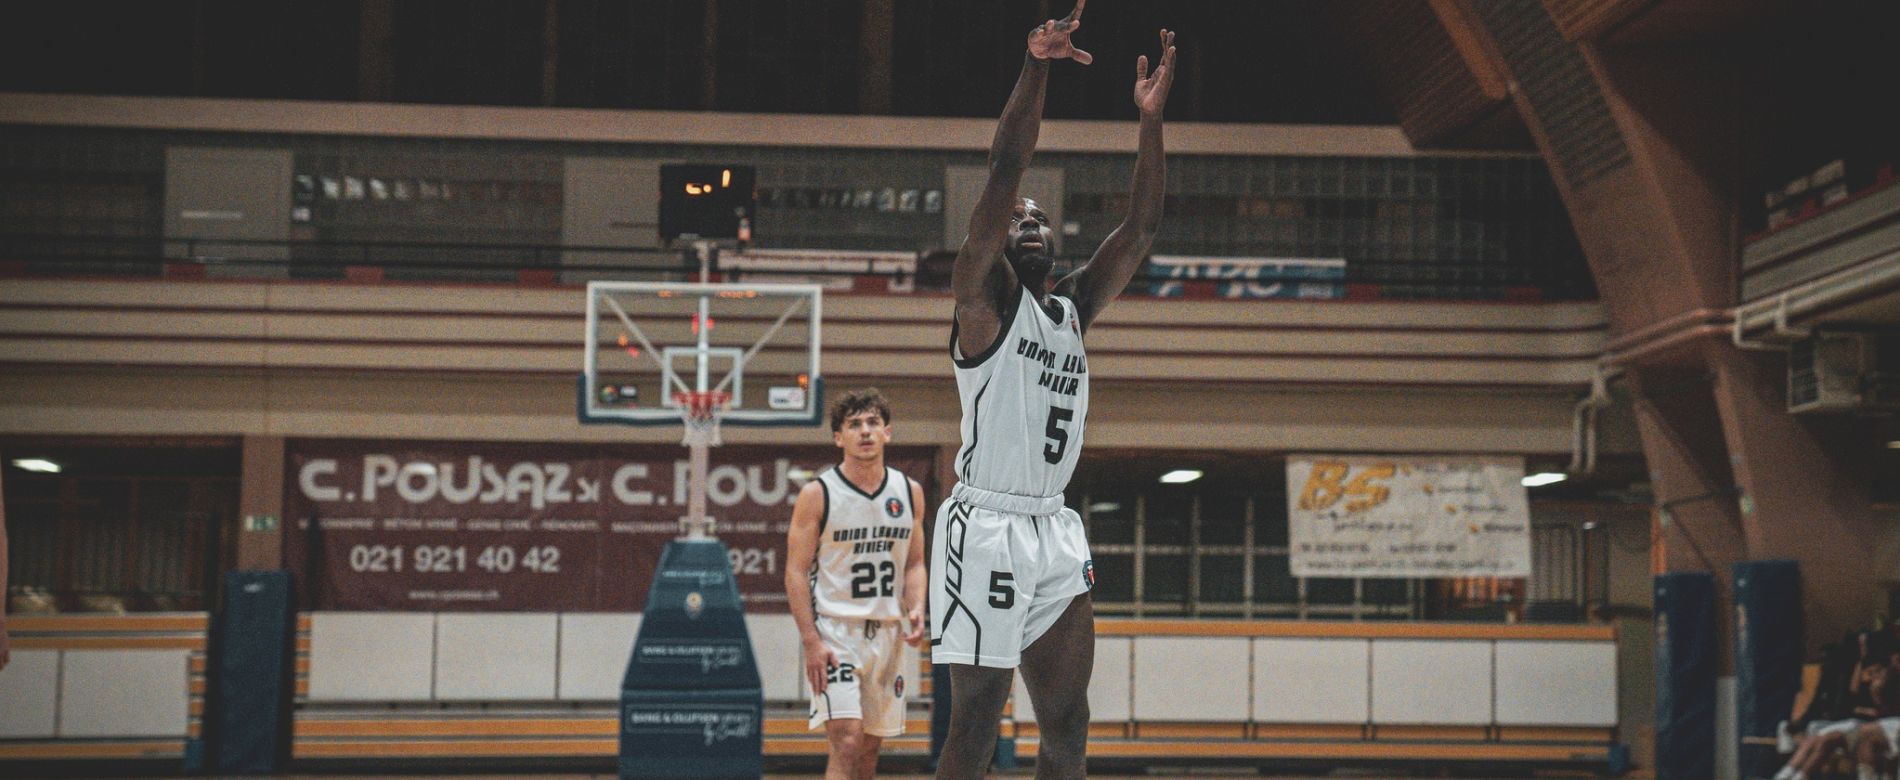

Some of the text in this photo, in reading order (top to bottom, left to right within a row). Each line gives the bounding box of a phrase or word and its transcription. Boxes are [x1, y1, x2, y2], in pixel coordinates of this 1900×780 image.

[1043, 405, 1074, 465] 5
[1298, 461, 1395, 513] BS
[833, 527, 868, 543] UNION
[351, 545, 561, 572] 021 921 40 42
[728, 548, 776, 575] 921
[851, 561, 895, 599] 22
[988, 570, 1015, 609] 5
[827, 662, 854, 683] 22
